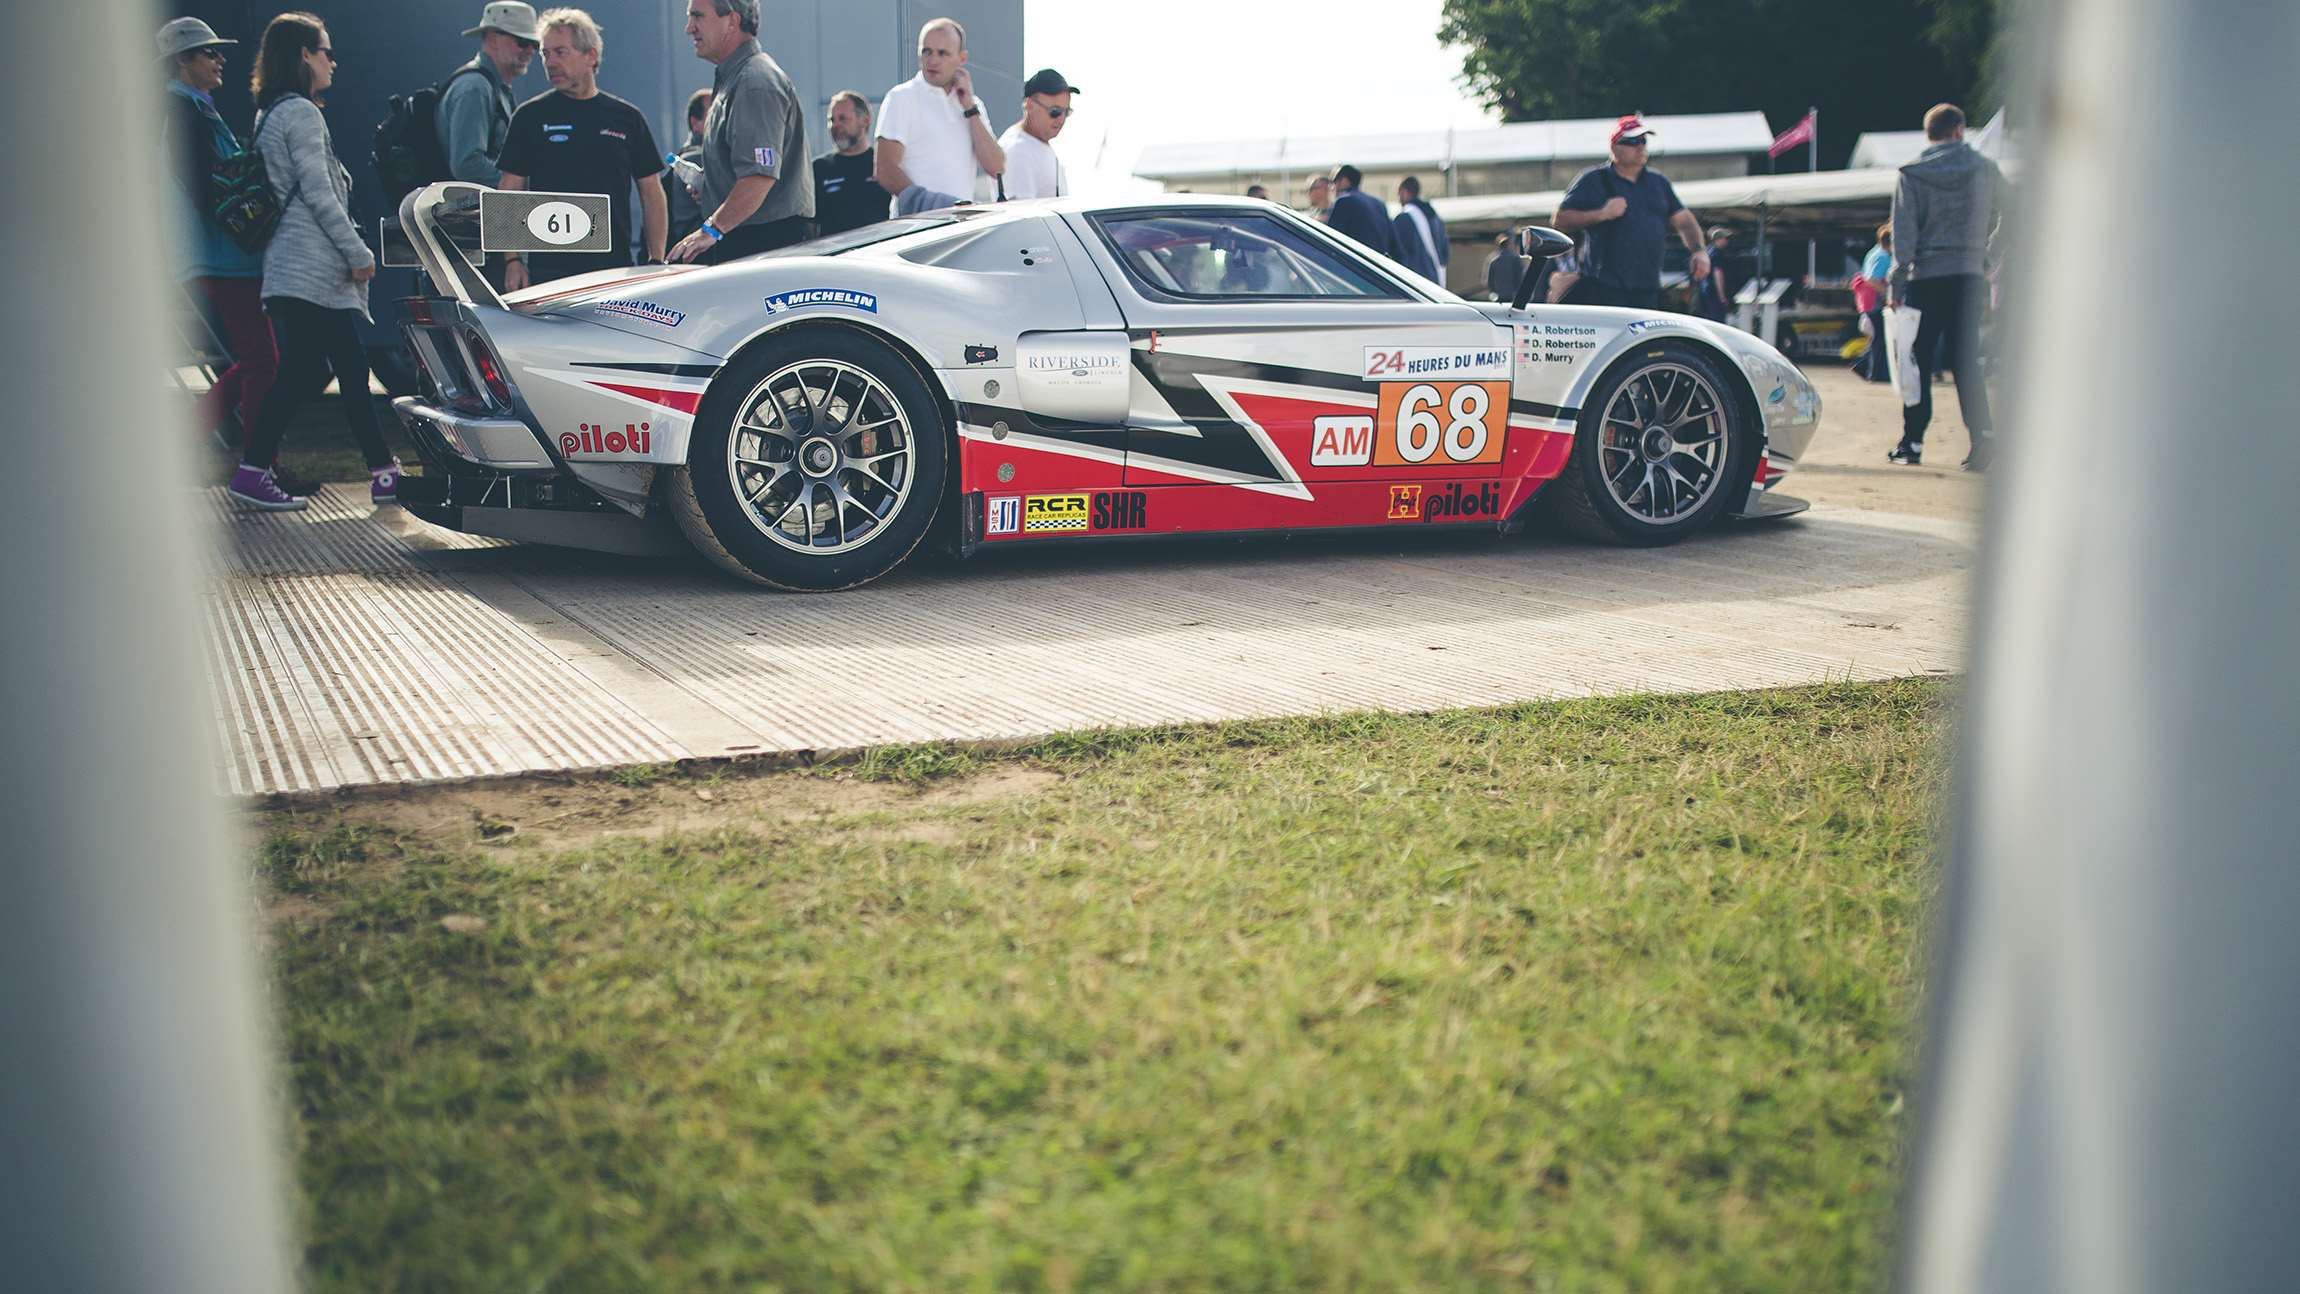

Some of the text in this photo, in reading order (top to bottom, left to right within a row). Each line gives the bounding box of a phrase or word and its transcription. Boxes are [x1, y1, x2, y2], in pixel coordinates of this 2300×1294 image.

[547, 213, 571, 233] 61
[788, 291, 874, 307] MICHELIN
[641, 301, 686, 321] Murry
[1532, 325, 1596, 335] A. Robertson
[1532, 339, 1596, 349] D. Robertson
[1028, 355, 1121, 369] RIVERSIDE
[1367, 350, 1508, 376] 24 HEURES DU MANS
[1532, 352, 1575, 365] D. Murry
[1396, 383, 1490, 463] 68
[559, 422, 649, 458] piloti
[1315, 426, 1369, 456] AM
[1028, 497, 1086, 513] RCR
[1093, 491, 1147, 530] SHR
[1424, 481, 1500, 523] piloti
[991, 501, 999, 531] IMSA
